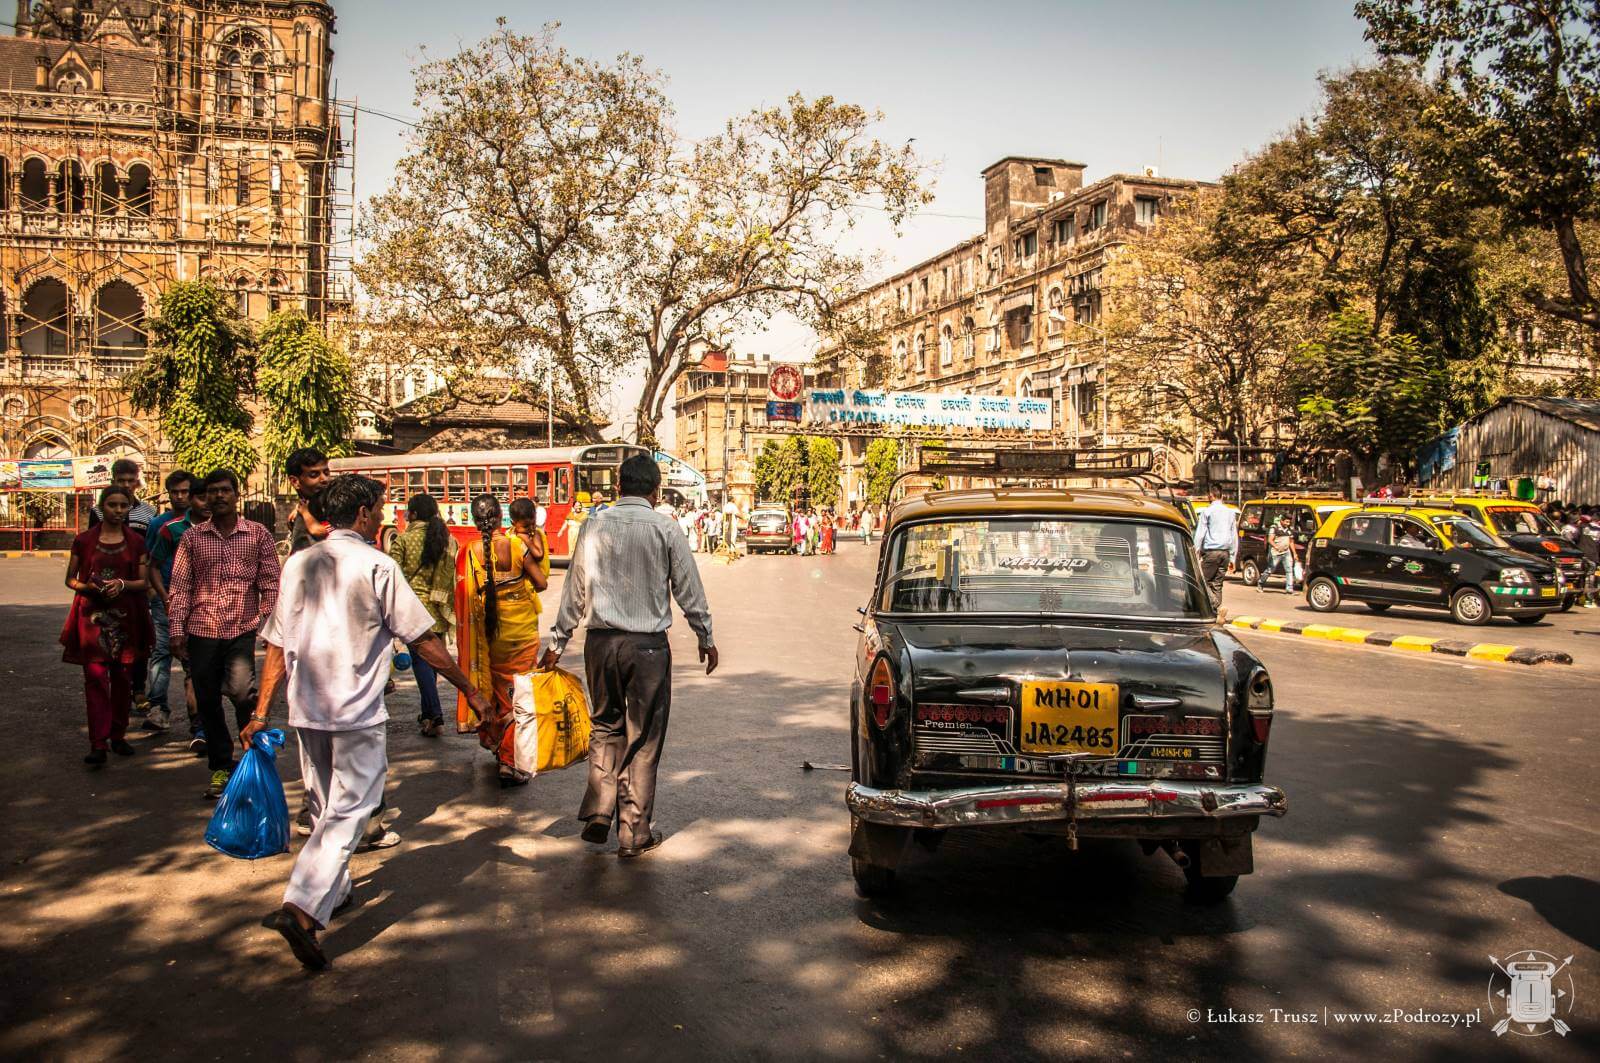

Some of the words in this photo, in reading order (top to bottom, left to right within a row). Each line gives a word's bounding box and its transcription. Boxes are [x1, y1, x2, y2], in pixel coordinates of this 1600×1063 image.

[829, 410, 912, 425] CHHATRAPATI
[921, 415, 966, 427] SHIVAJI
[975, 416, 1031, 430] TERMINUS
[924, 719, 973, 730] Premier
[1015, 758, 1119, 777] DELUXE
